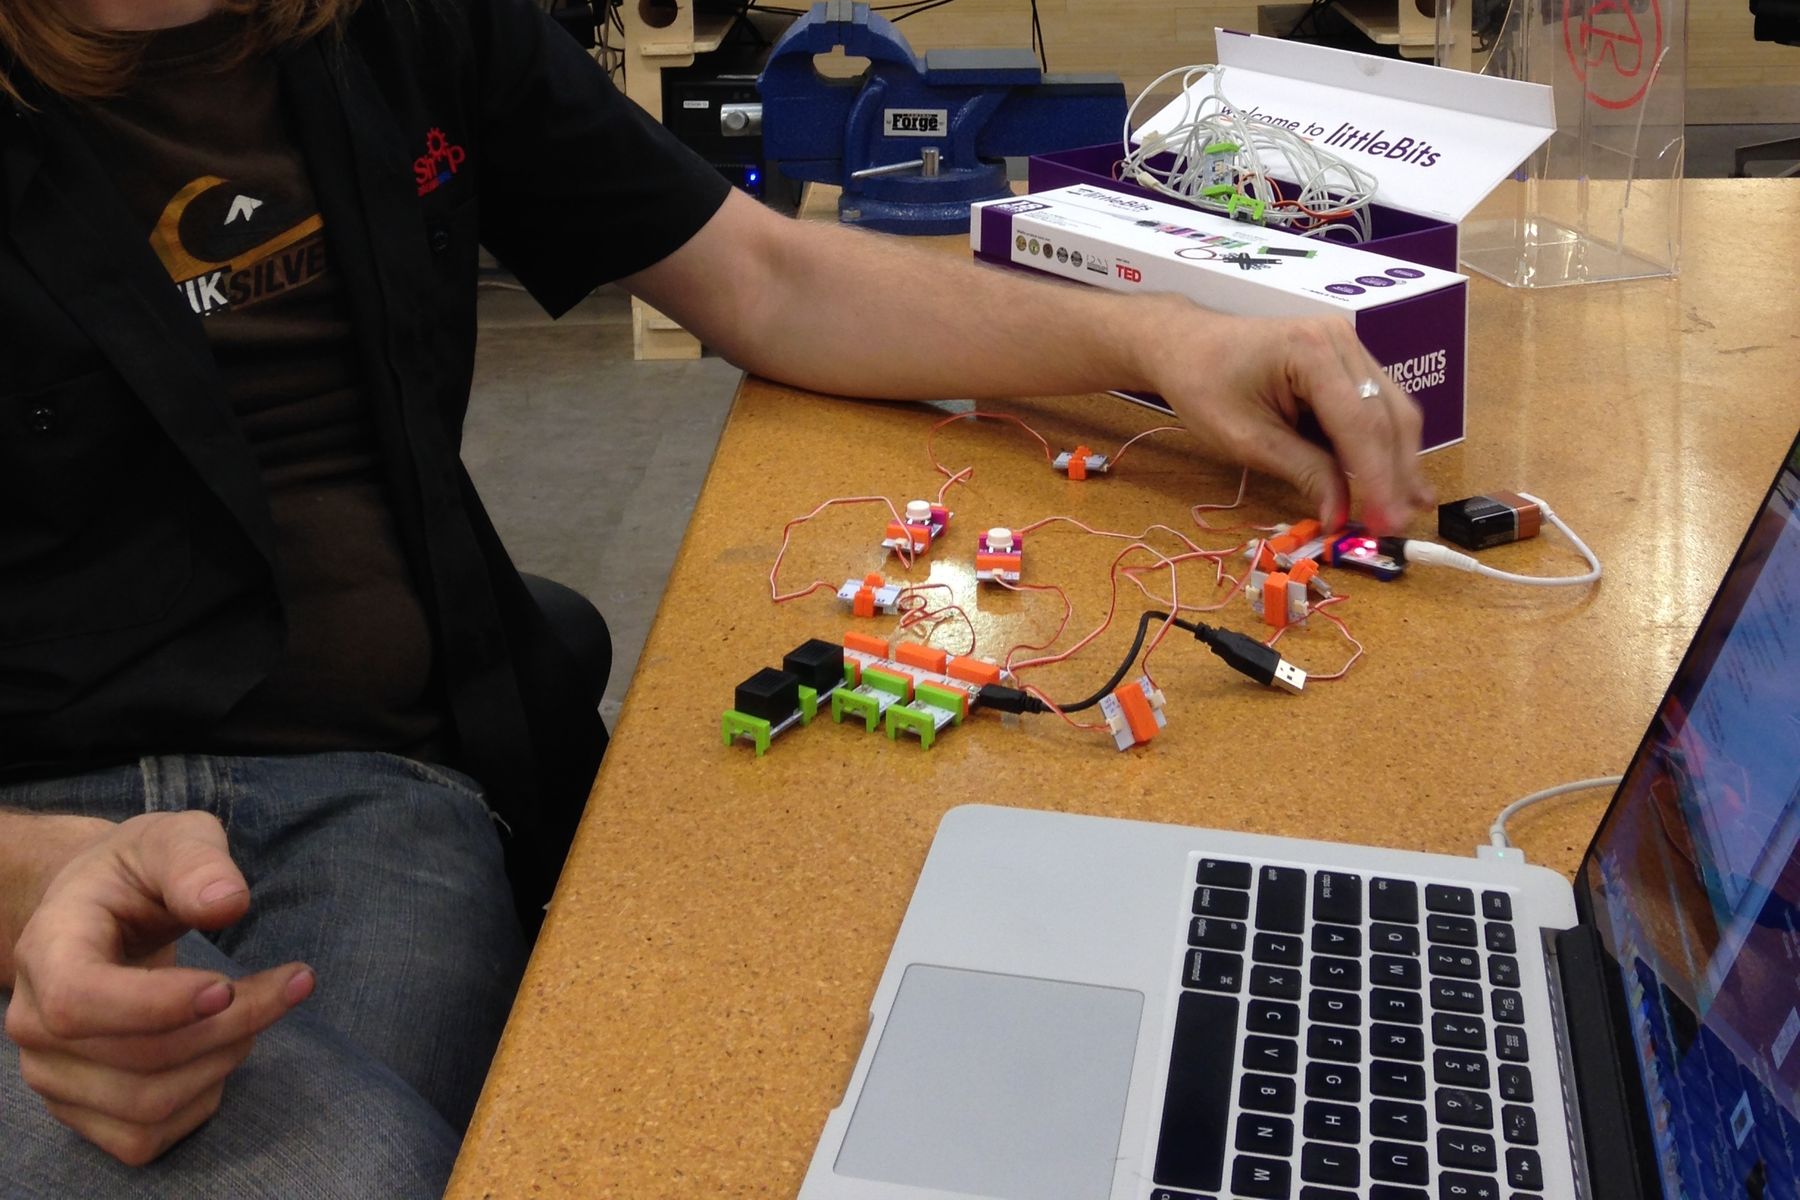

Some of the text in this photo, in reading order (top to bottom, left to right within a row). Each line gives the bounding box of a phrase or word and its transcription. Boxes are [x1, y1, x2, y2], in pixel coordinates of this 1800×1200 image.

[892, 113, 940, 132] Forge
[1220, 106, 1442, 168] wlcome to littleBits
[1116, 264, 1142, 283] TED
[1397, 370, 1445, 394] ECONDS
[1330, 934, 1344, 942] A
[1388, 932, 1402, 942] Q
[1271, 944, 1286, 952] Z
[1390, 964, 1404, 975] W
[1269, 976, 1284, 985] X
[1328, 1001, 1343, 1010] D
[1266, 1012, 1282, 1020] C
[1464, 1026, 1478, 1034] $
[1390, 1035, 1406, 1044] R
[1264, 1049, 1279, 1057] V
[1445, 1061, 1460, 1069] 5
[1466, 1064, 1481, 1072] %
[1326, 1075, 1342, 1085] G
[1260, 1088, 1277, 1096] B
[1447, 1100, 1462, 1109] 6
[1325, 1115, 1341, 1125] H
[1392, 1115, 1408, 1123] Y
[1257, 1127, 1273, 1137] N
[1449, 1143, 1464, 1151] 7
[1392, 1155, 1408, 1166] U
[1254, 1168, 1270, 1181] M
[1450, 1186, 1467, 1194] 8
